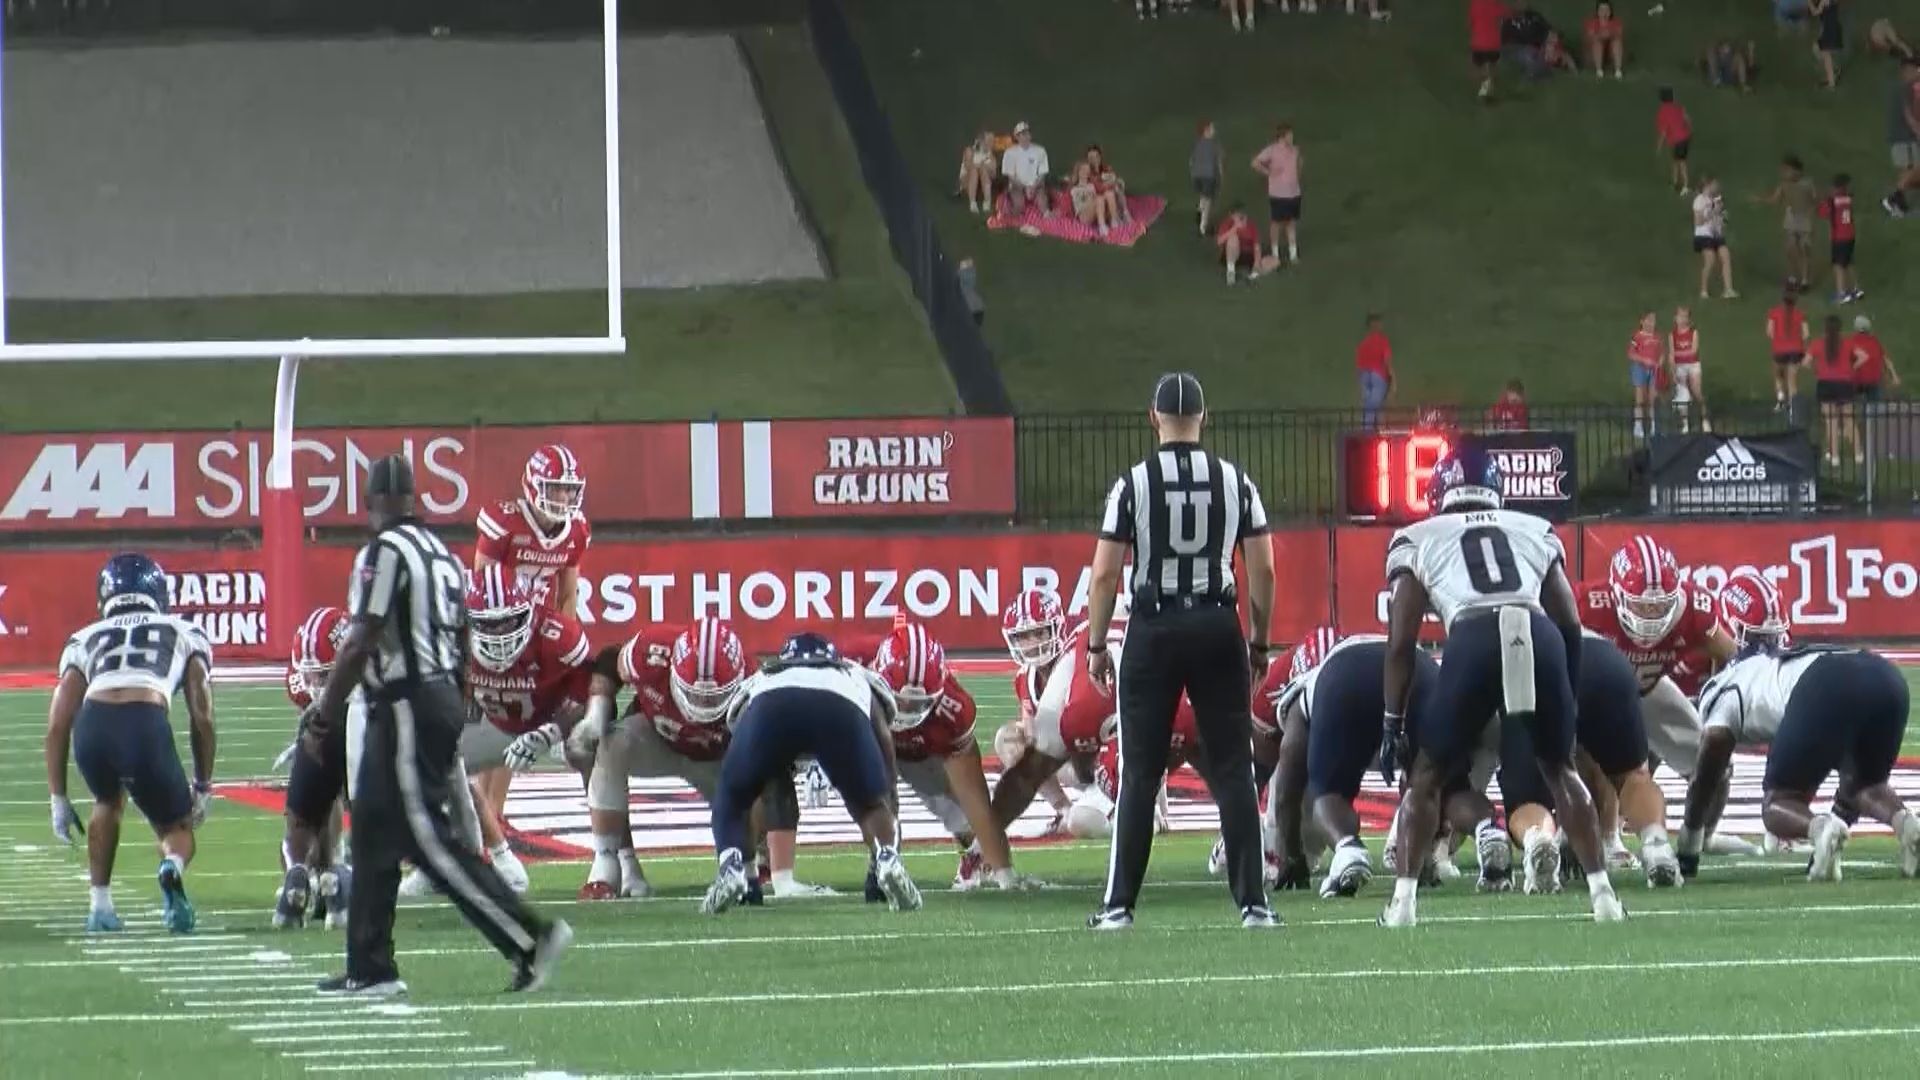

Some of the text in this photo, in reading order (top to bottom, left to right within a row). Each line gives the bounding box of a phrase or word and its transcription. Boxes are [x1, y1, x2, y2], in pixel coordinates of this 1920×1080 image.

[0, 437, 468, 519] AAA SIGNS
[815, 473, 949, 504] CAJUNS
[1698, 463, 1767, 481] adidas
[1165, 491, 1212, 554] U
[1460, 525, 1522, 594] 0
[576, 572, 675, 623] RST
[693, 568, 999, 621] HORIZON
[85, 622, 178, 679] 29
